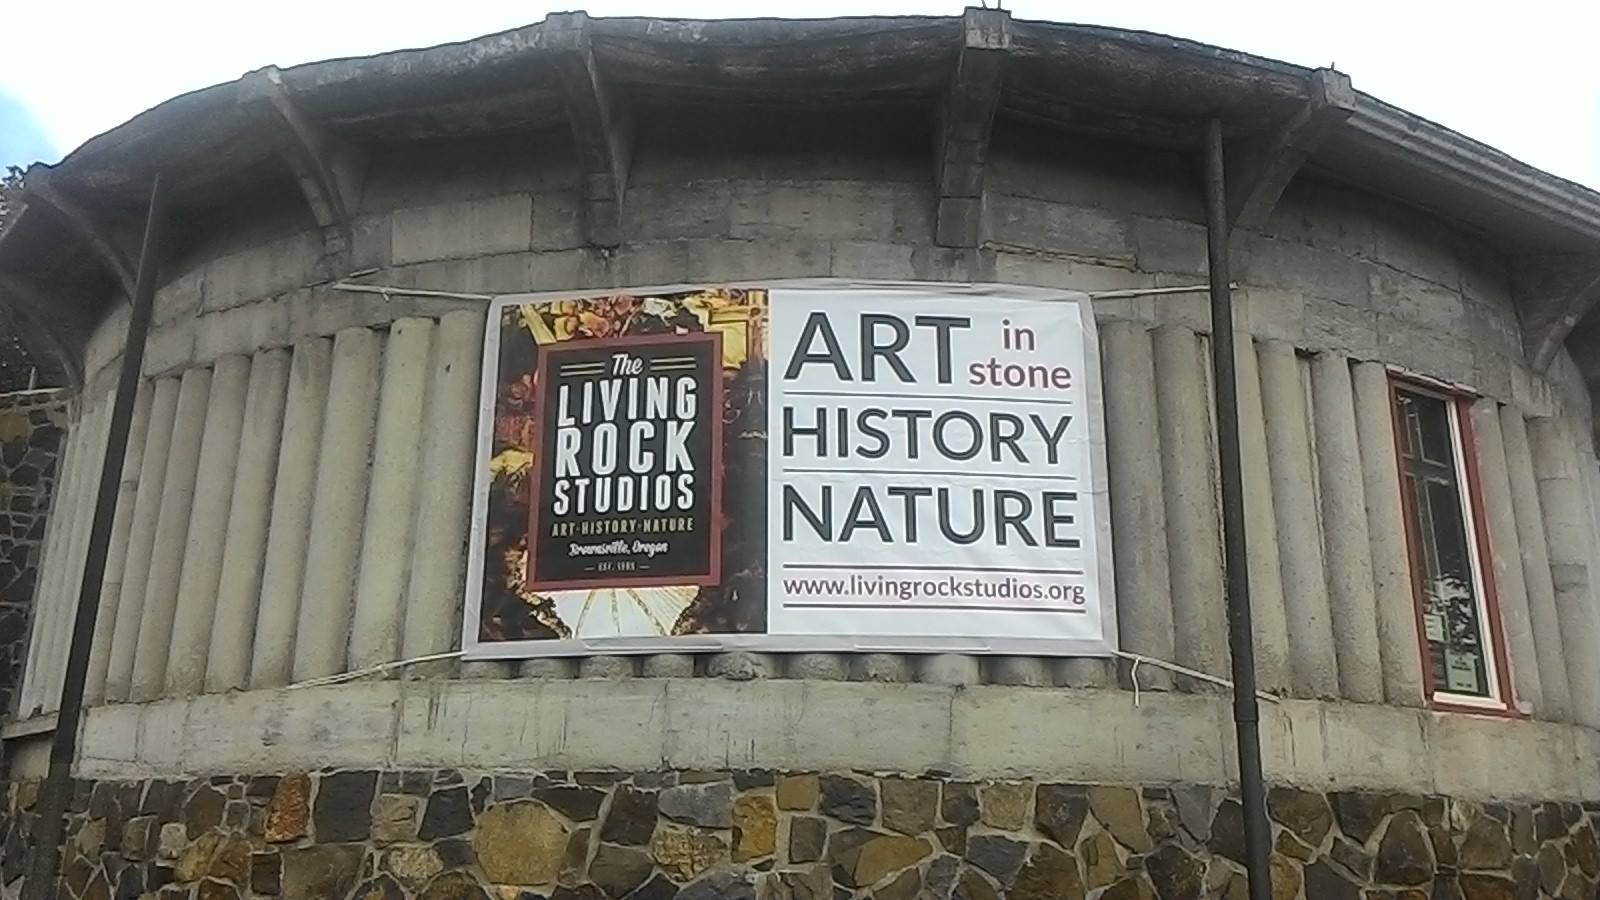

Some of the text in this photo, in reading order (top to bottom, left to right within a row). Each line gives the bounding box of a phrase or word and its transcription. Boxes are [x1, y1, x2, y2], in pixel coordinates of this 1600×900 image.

[783, 311, 971, 384] ART
[1002, 319, 1035, 351] in
[612, 353, 644, 376] The
[969, 357, 1072, 389] stone
[558, 376, 697, 427] LIVING
[555, 421, 695, 478] ROCK
[782, 406, 1073, 464] HISTORY
[553, 473, 694, 515] STUDIOS
[782, 484, 1081, 549] NATURE
[632, 540, 669, 558] Oregon
[782, 575, 1086, 605] www.livingrockstudios.org
